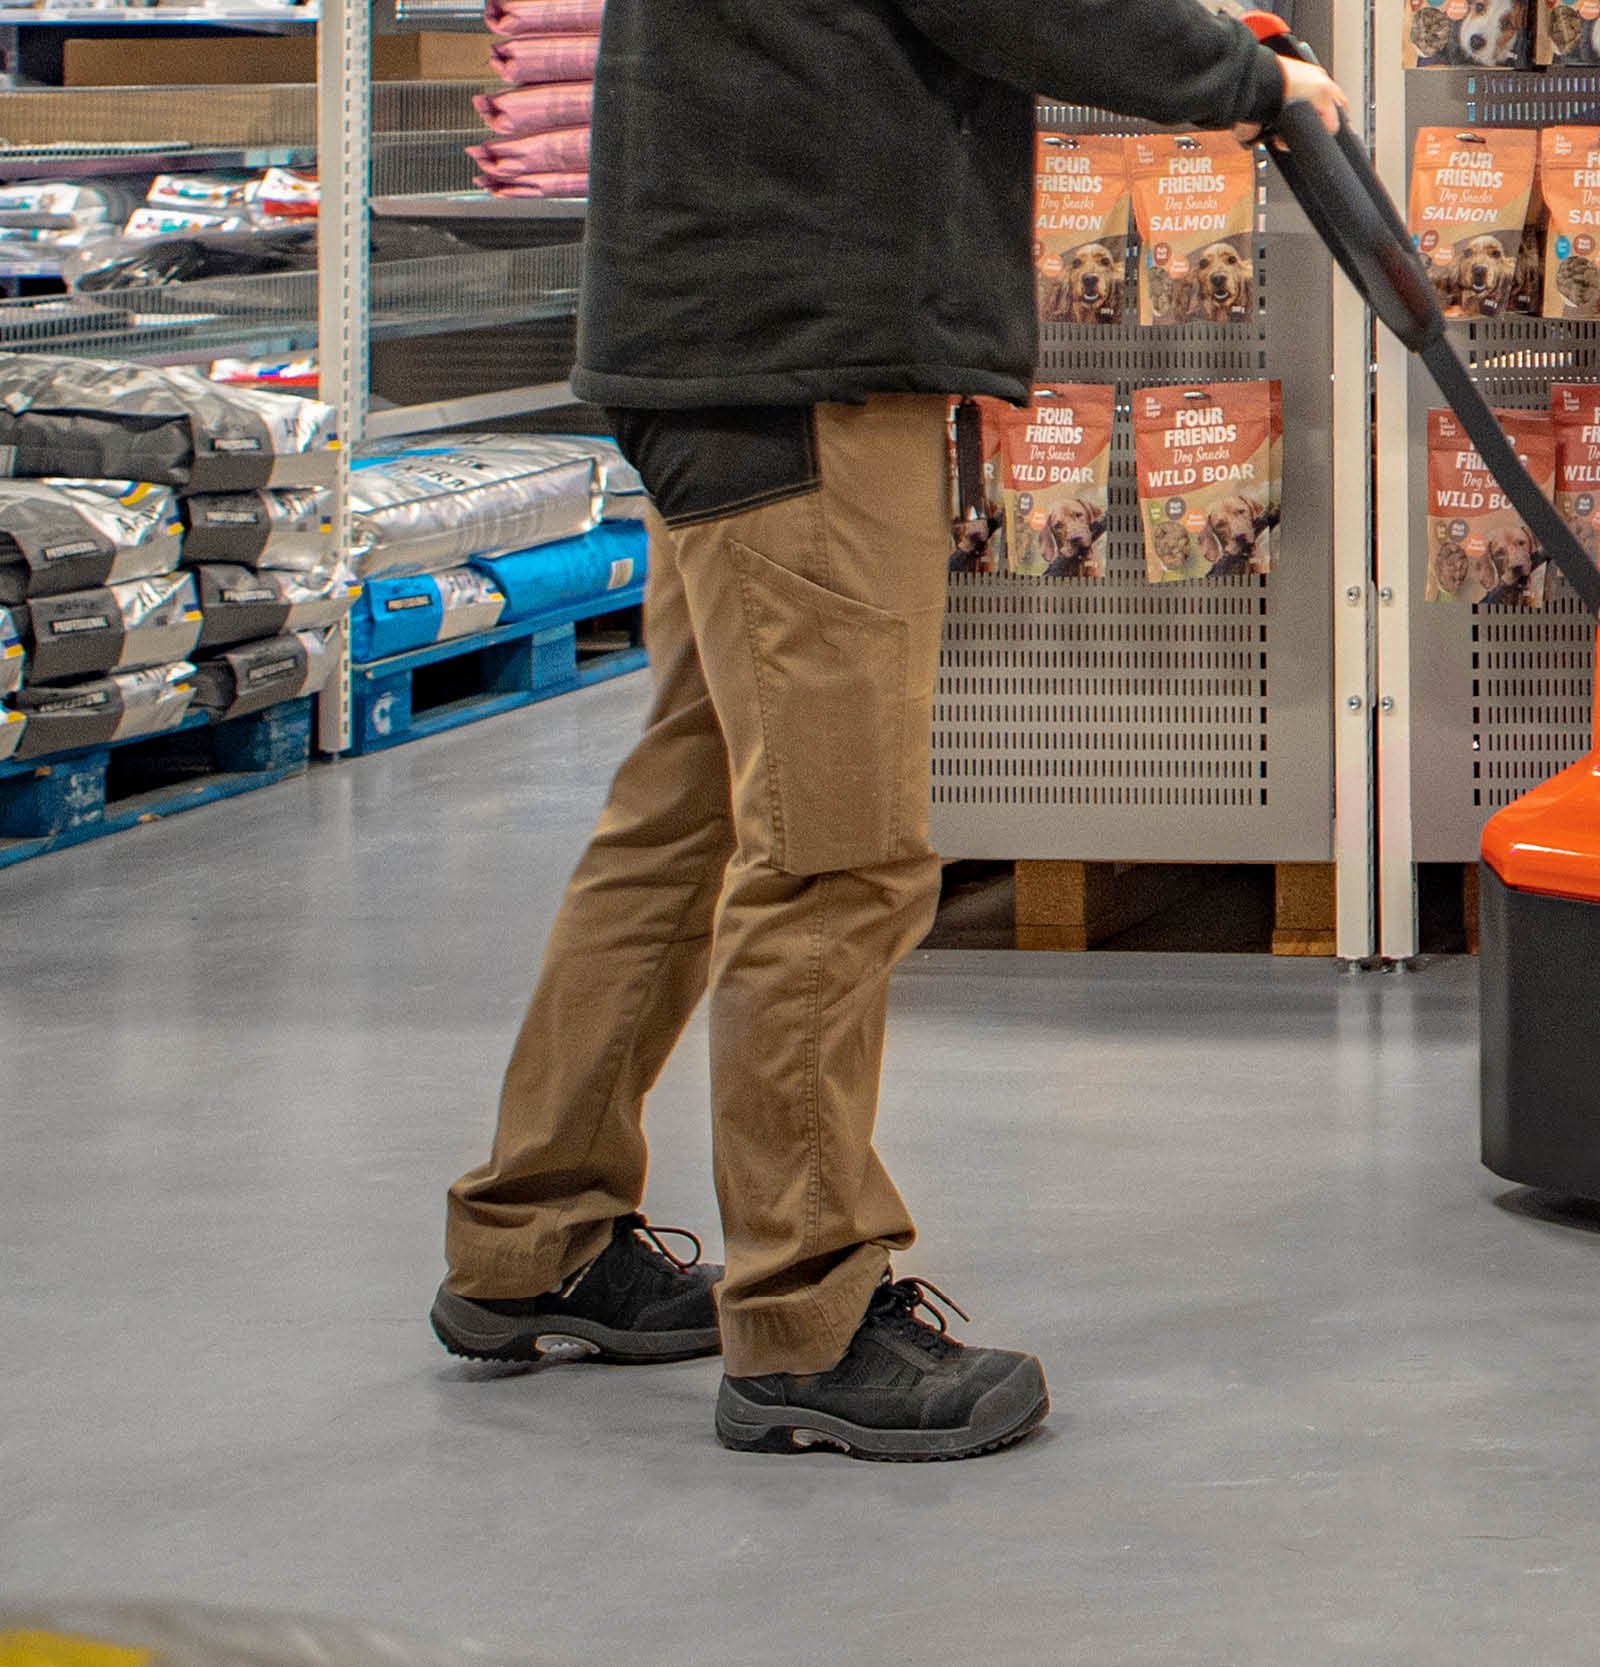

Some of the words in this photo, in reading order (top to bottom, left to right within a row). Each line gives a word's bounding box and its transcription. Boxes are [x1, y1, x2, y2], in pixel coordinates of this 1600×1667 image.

[1045, 156, 1091, 174] FOUR
[1168, 156, 1213, 175] FOUR
[1448, 151, 1494, 169] FOUR
[1035, 174, 1103, 193] FRIENDS
[1158, 174, 1225, 195] FRIENDS
[1435, 168, 1504, 189] FRIENDS
[1036, 213, 1103, 231] ALMON
[1149, 214, 1226, 232] SALMON
[1421, 205, 1499, 223] SALMON
[1037, 407, 1074, 426] FOUR
[1175, 407, 1224, 428] FOUR
[1025, 425, 1083, 445] FRIENDS
[1164, 424, 1238, 448] FRIENDS
[1050, 465, 1095, 483] BOAR
[1148, 468, 1197, 488] WILD
[1202, 463, 1256, 483] BOAR
[1437, 490, 1485, 509] WILD
[1488, 494, 1514, 510] BO
